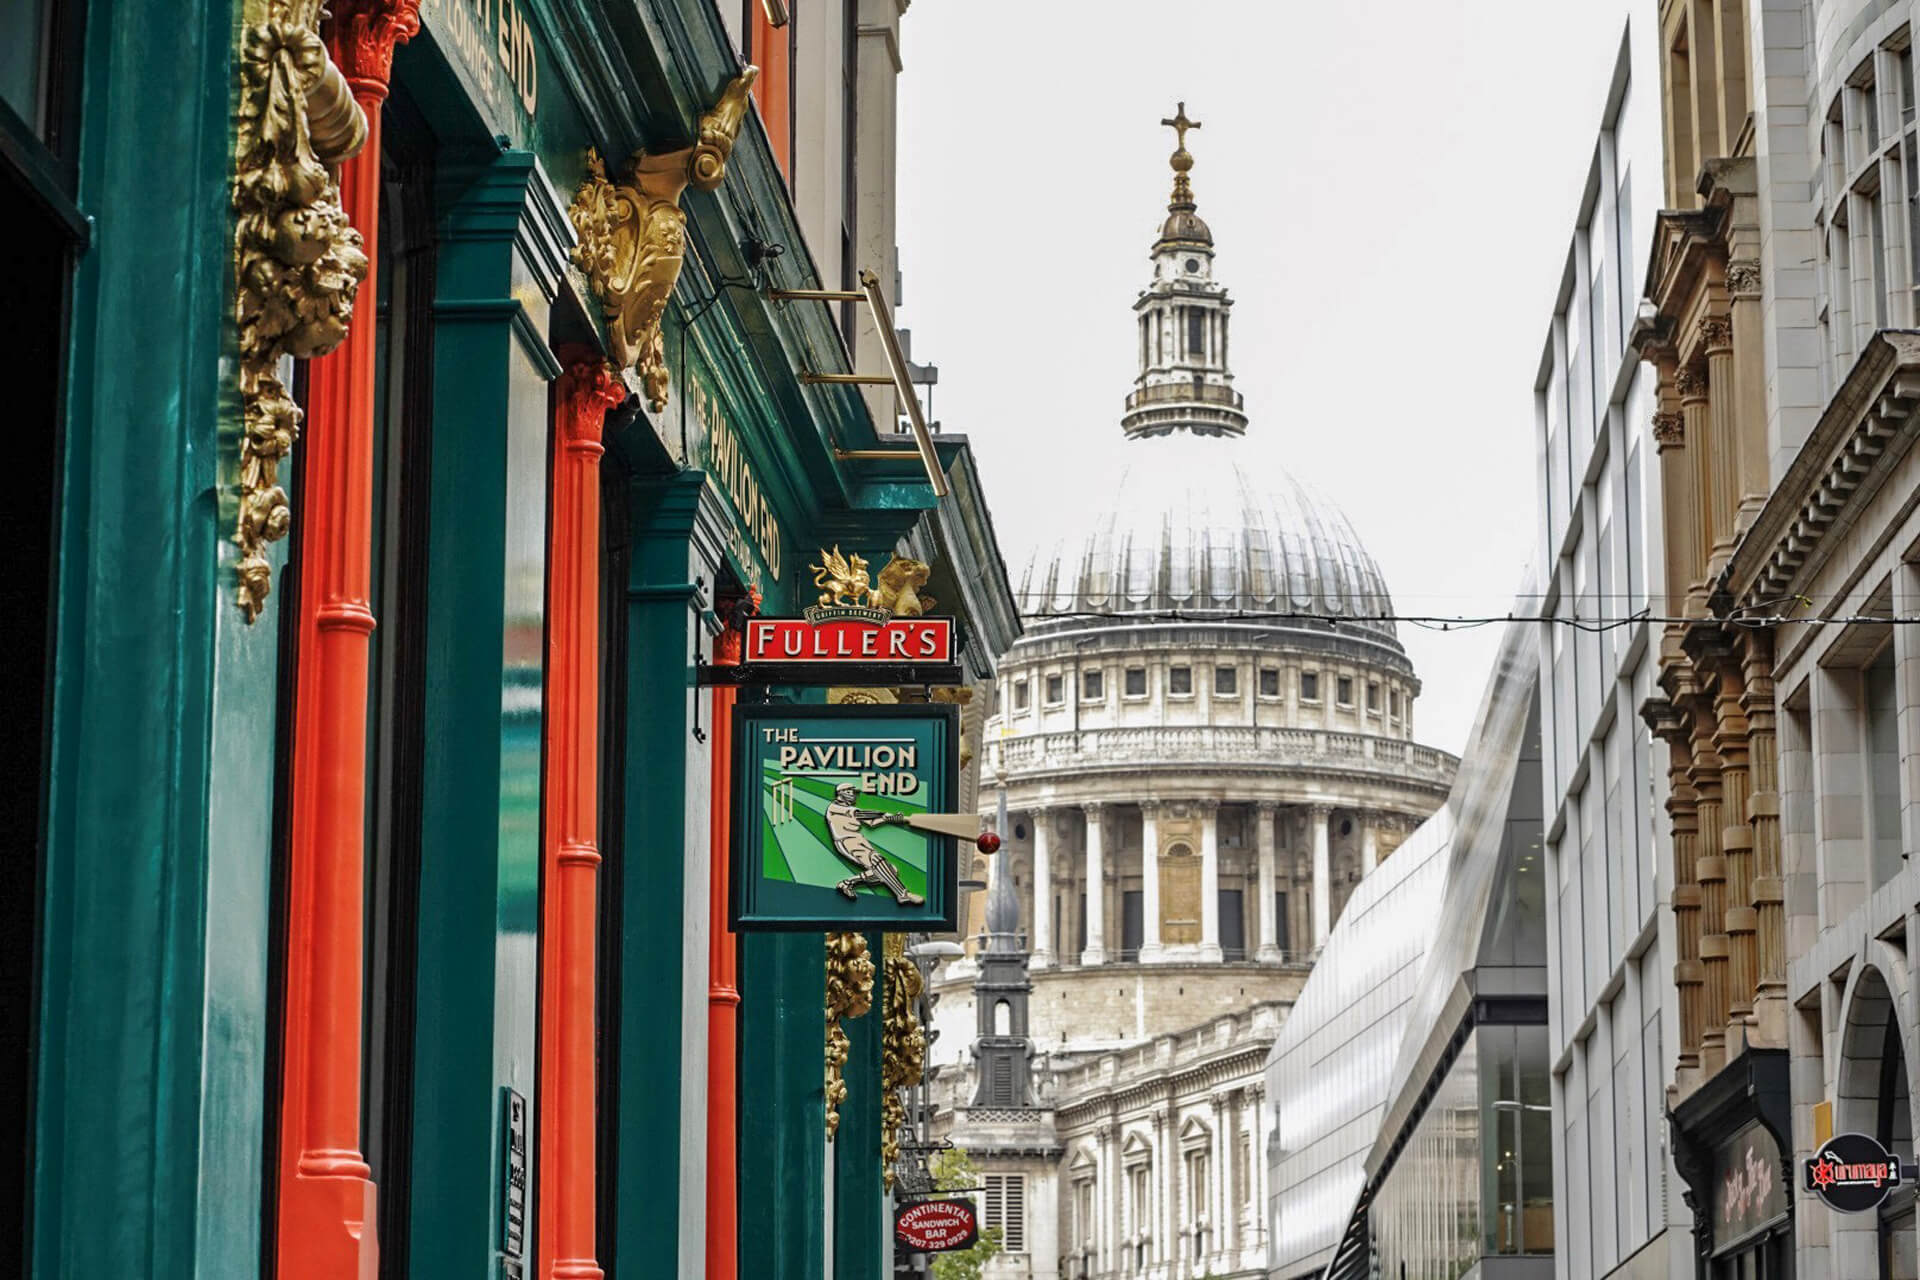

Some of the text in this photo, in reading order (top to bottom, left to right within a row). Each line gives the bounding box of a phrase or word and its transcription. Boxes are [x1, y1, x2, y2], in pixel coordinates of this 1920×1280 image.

[498, 0, 537, 115] END
[711, 394, 758, 544] PAVILION
[760, 493, 780, 582] END
[757, 624, 937, 657] FULLER'S
[762, 728, 799, 743] THE
[780, 745, 916, 769] PAVILION
[860, 771, 919, 794] END
[900, 1203, 971, 1228] CONTINENTAL
[911, 1218, 960, 1230] SANDWICH
[925, 1228, 948, 1240] BAR
[928, 1240, 946, 1249] 329
